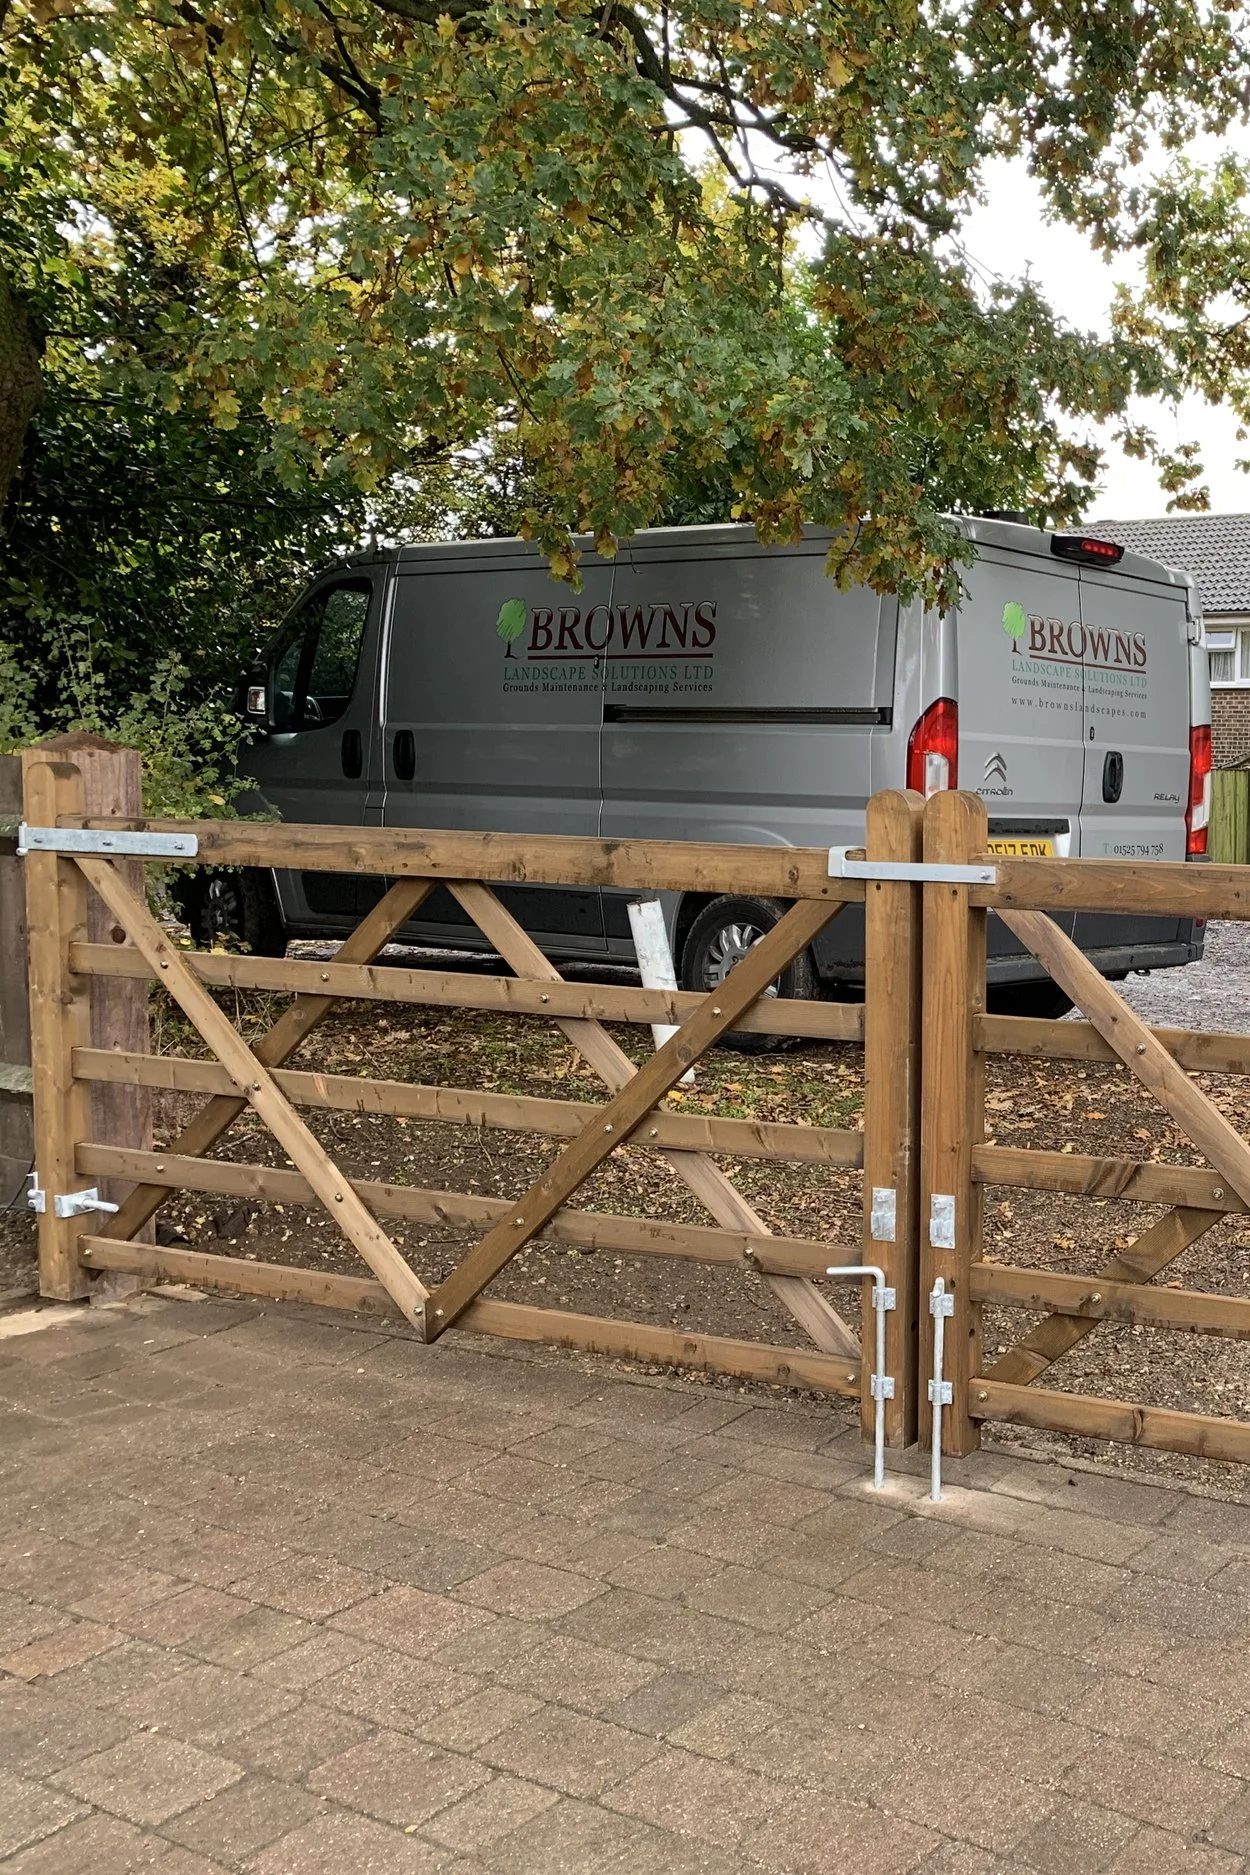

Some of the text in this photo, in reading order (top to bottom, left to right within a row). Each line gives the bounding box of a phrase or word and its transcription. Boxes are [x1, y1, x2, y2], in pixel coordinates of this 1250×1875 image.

[527, 600, 718, 650] BROWNS
[1027, 614, 1147, 667] BROWNS
[504, 665, 714, 681] LANDSCAPE SOLUTIONS LTD
[1012, 659, 1148, 689] LANDSCAPE SOLUTIONS LTD
[503, 682, 539, 692] Grounds
[542, 682, 598, 692] Maintenance
[611, 681, 669, 694] Landscaping
[672, 681, 713, 692] Services
[1011, 675, 1039, 688] Grounds
[1041, 679, 1080, 692] Maintenance
[1088, 685, 1124, 699] Landscaping
[1125, 689, 1148, 700] Services
[1011, 696, 1147, 719] www.brownslandscapes.com
[1153, 793, 1180, 803] RELAY
[1113, 845, 1135, 856] 01525
[1137, 845, 1149, 856] 794
[1151, 843, 1164, 856] 758
